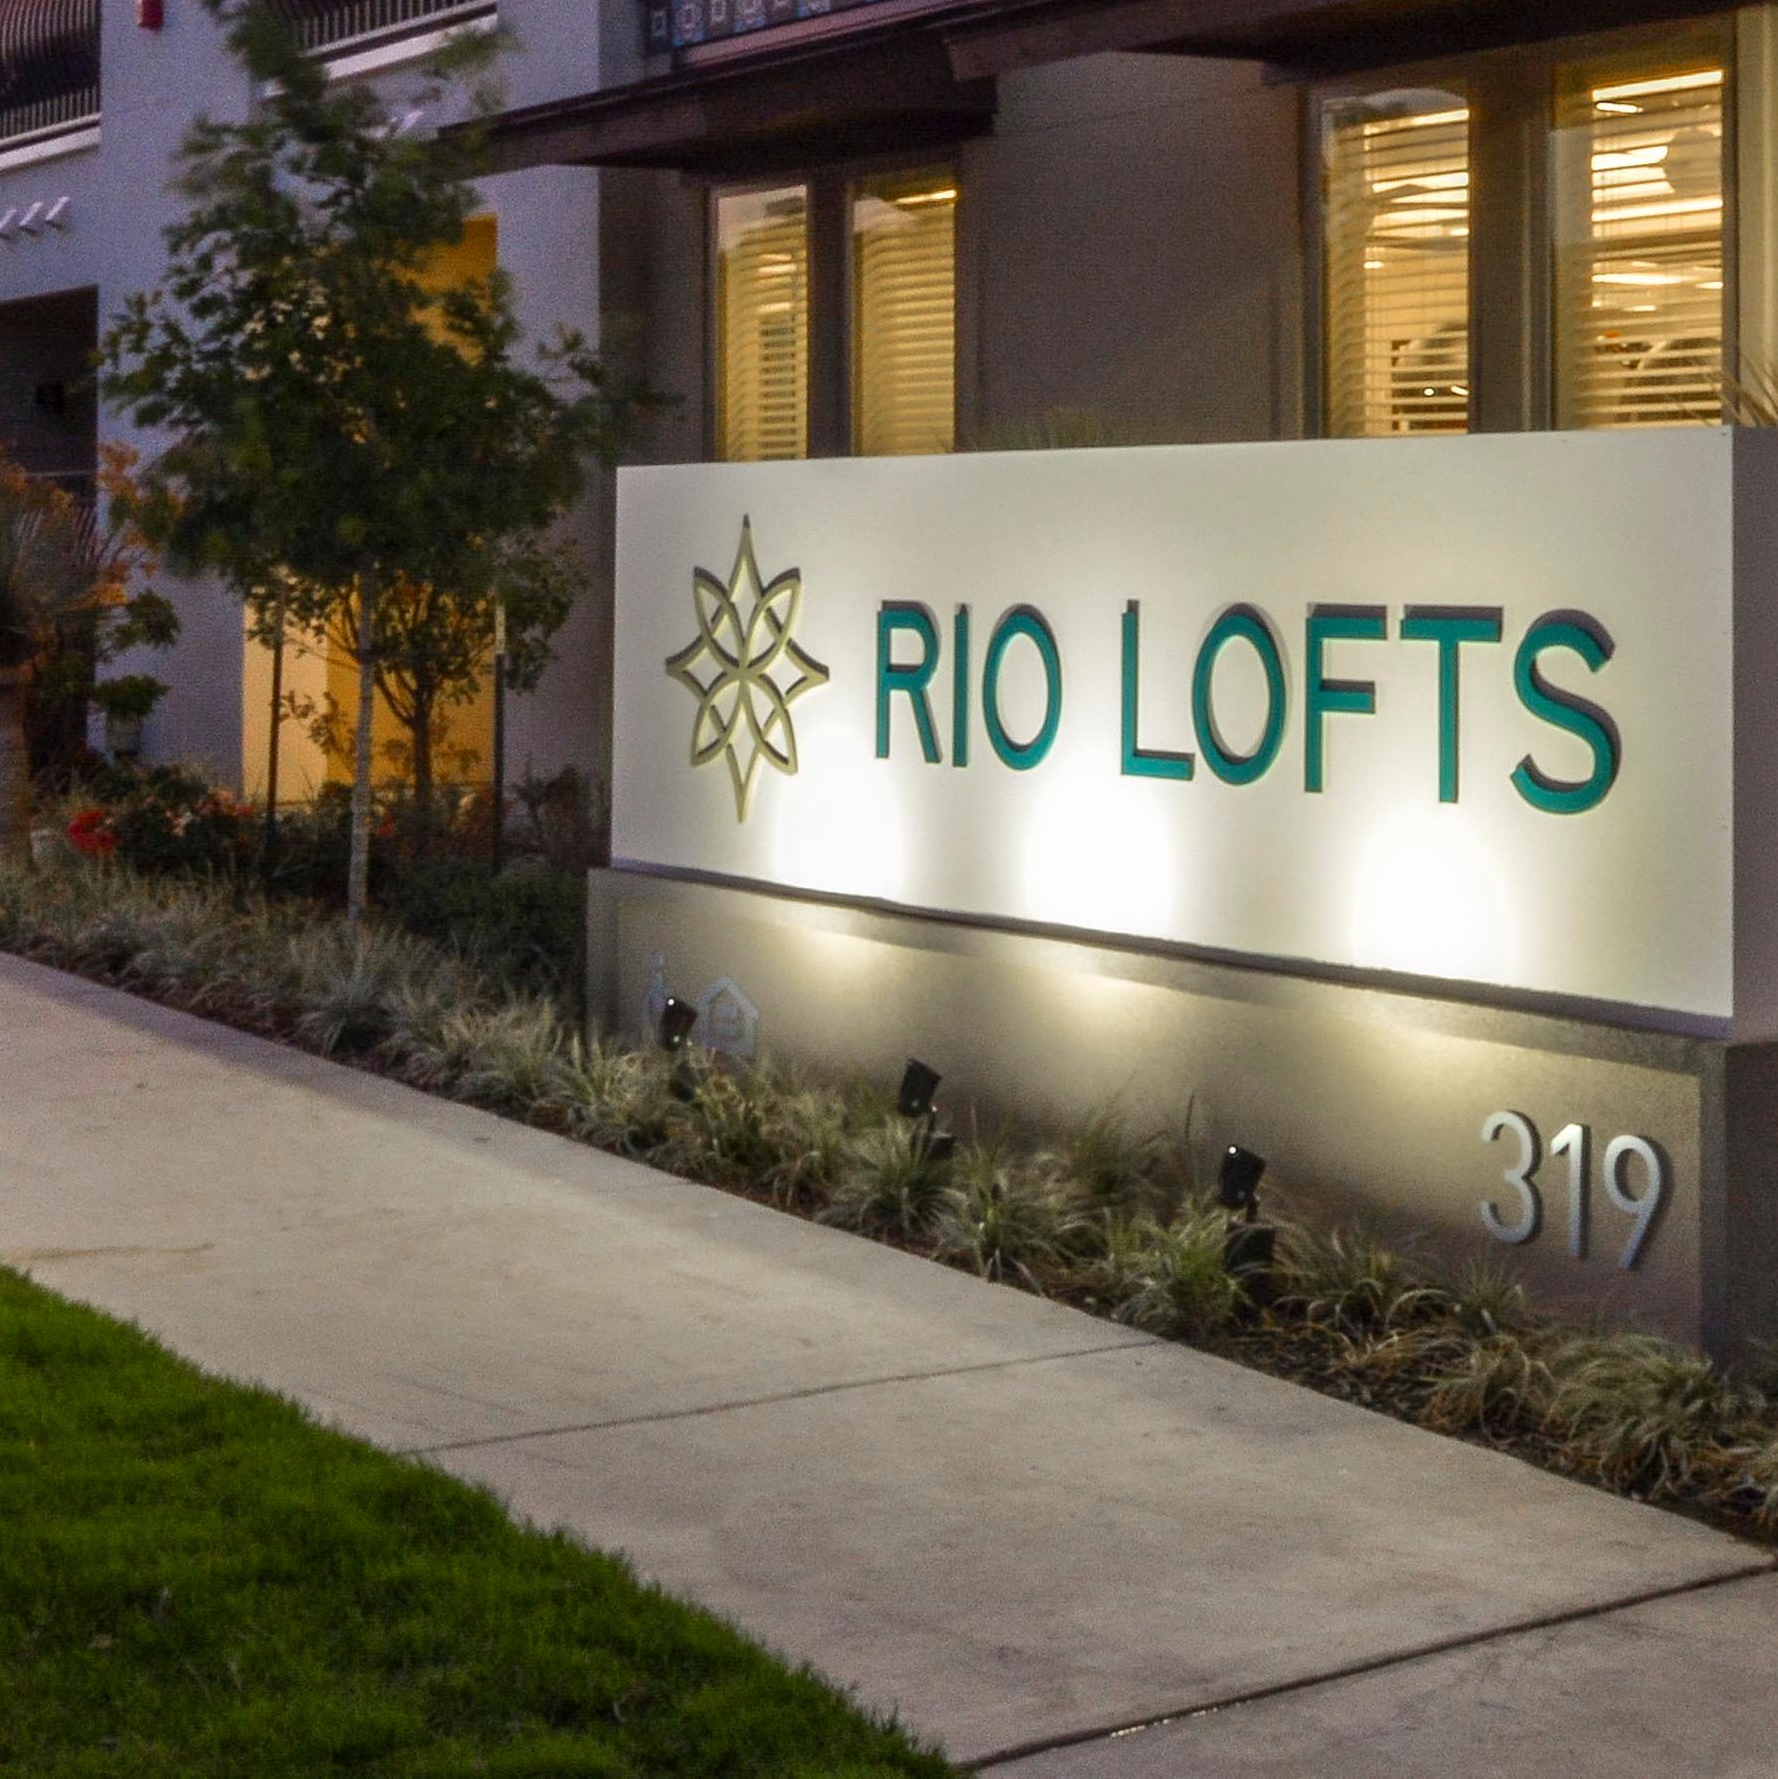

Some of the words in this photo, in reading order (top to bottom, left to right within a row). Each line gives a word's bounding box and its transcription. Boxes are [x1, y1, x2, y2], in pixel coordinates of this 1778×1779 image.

[874, 599, 1063, 771] RIO
[1120, 599, 1622, 815] LOFTS
[1479, 1109, 1671, 1269] 319
